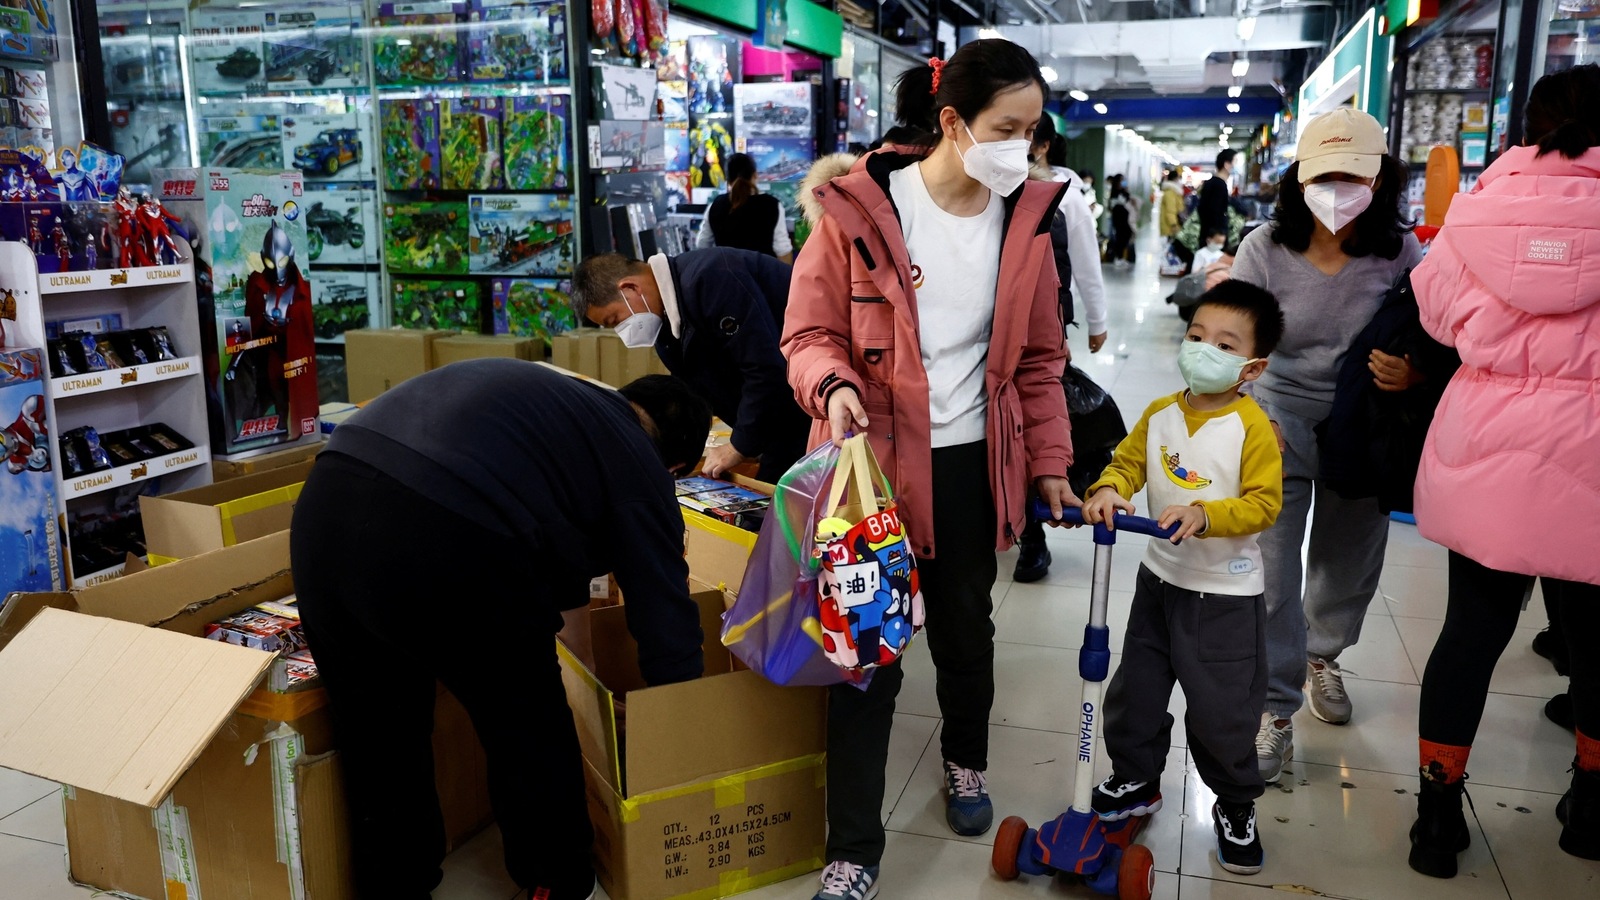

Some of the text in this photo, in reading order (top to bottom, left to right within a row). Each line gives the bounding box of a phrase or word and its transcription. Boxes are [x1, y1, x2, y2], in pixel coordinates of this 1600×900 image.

[1527, 252, 1564, 260] COOLEST
[50, 269, 181, 286] ULTRAMAN ULTRAMAN
[62, 362, 189, 391] ULTRAMAN ULTRAMAN
[74, 452, 198, 491] ULTRAMAN ULTRAMAN
[829, 546, 845, 563] M
[1079, 702, 1094, 763] OPHANIE
[709, 814, 720, 826] 12
[747, 803, 765, 816] PCS
[708, 840, 730, 855] 3.84
[747, 831, 765, 845] KGS
[708, 854, 731, 868] 2.90
[748, 845, 766, 858] KGS
